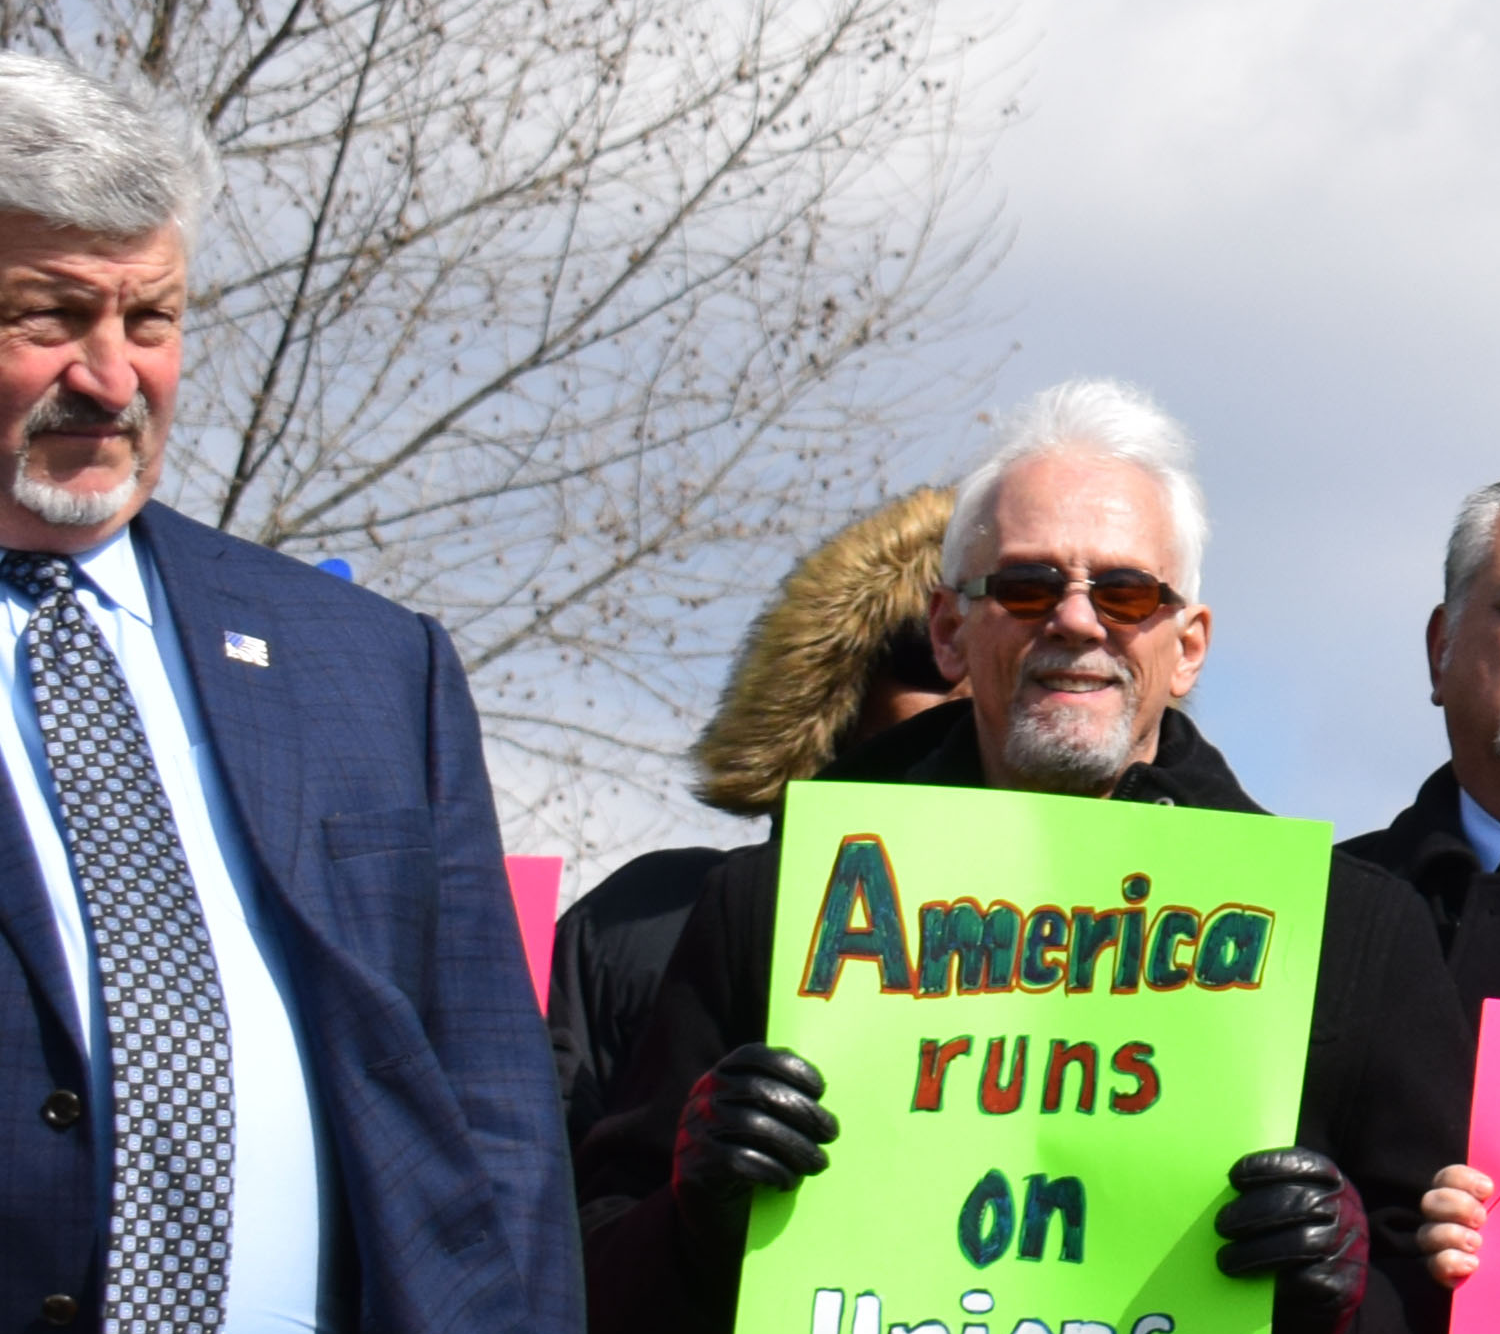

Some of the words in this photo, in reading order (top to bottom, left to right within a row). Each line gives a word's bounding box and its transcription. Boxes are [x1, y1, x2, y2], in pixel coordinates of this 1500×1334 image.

[798, 833, 1276, 1000] America
[911, 1033, 1162, 1115] runs
[957, 1167, 1087, 1269] on
